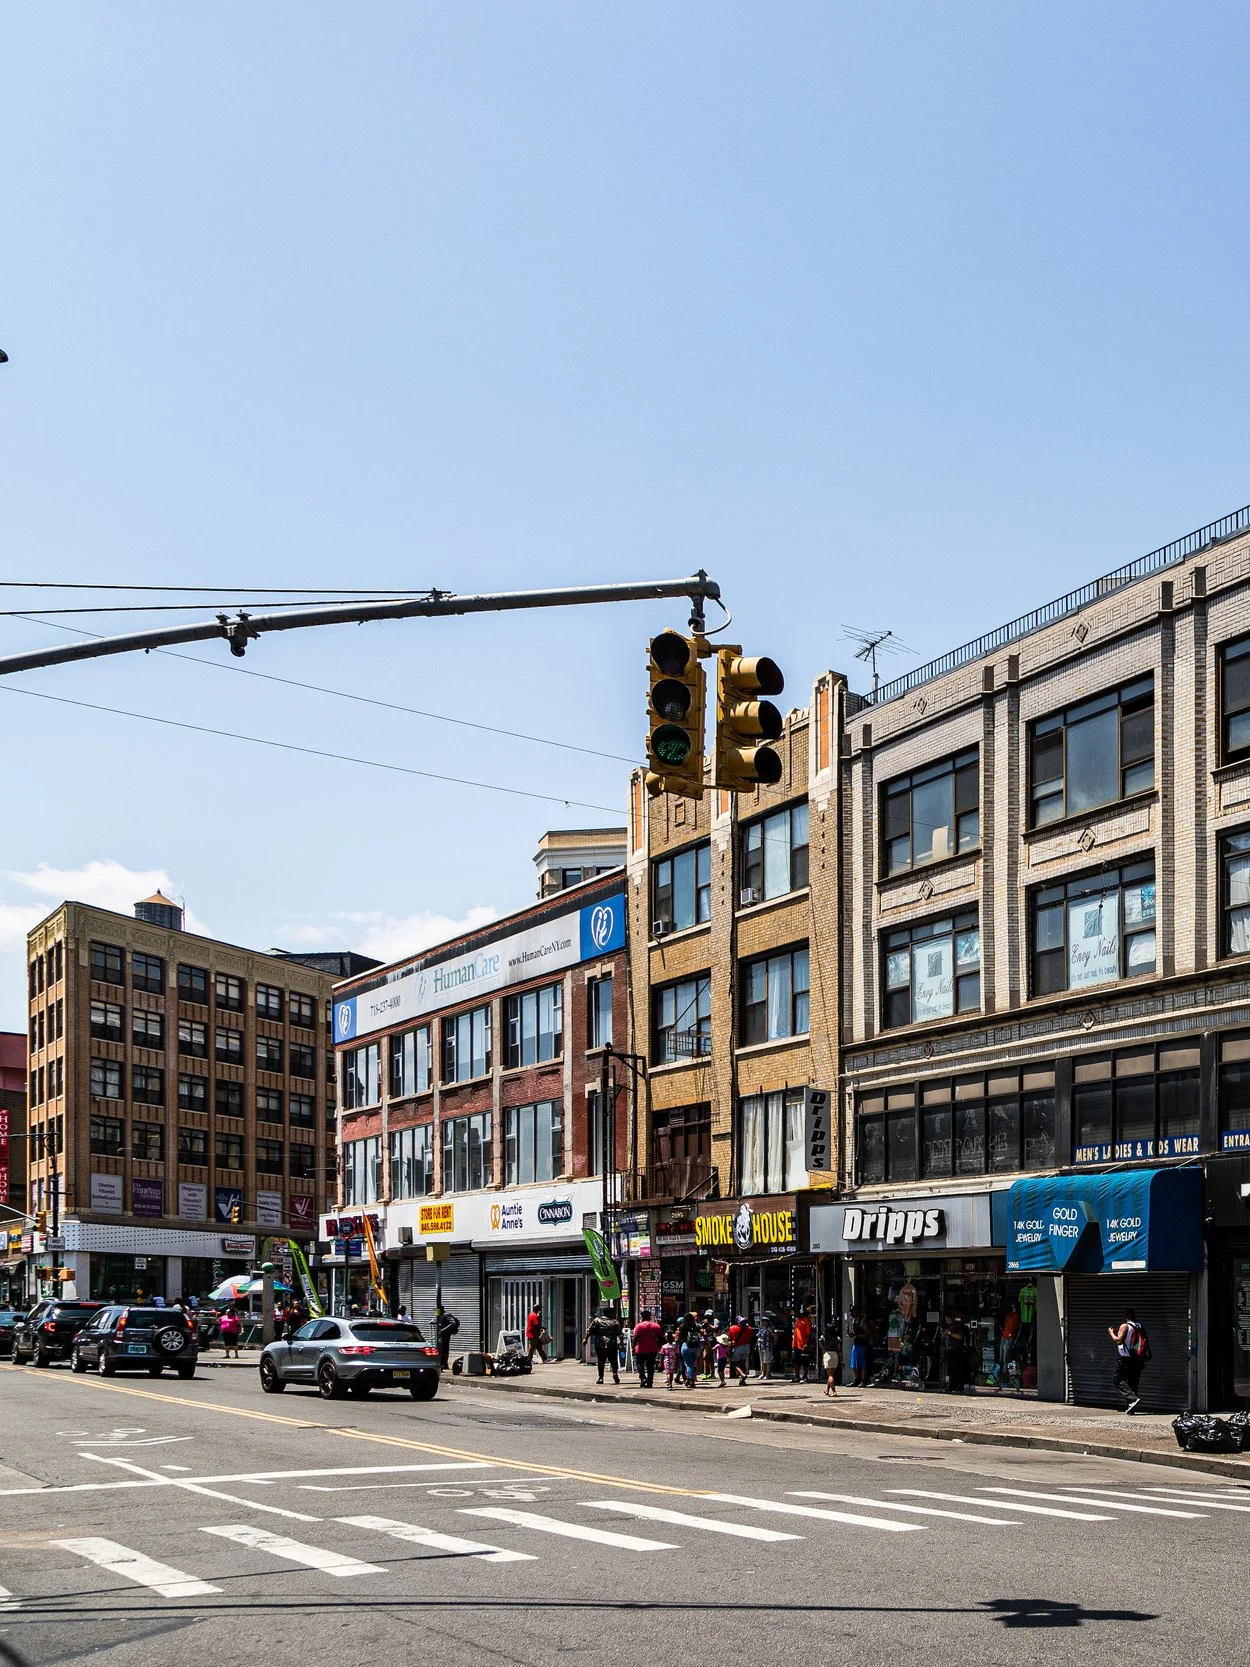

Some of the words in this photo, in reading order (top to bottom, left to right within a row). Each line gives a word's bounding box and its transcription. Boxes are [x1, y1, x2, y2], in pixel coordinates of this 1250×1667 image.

[508, 938, 571, 968] www.HumanCareNY.com
[1093, 935, 1117, 959] Nails
[433, 953, 500, 993] HumanCare
[370, 995, 401, 1017] 718-237-4000
[810, 1092, 826, 1167] Dripps
[1076, 1147, 1098, 1162] MEN'S
[1137, 1143, 1142, 1156] &
[1147, 1141, 1169, 1156] KDS
[1174, 1137, 1199, 1154] WEAR
[421, 1208, 432, 1220] STORE
[442, 1206, 451, 1219] RENT
[501, 1203, 522, 1216] Auntie
[539, 1205, 571, 1221] CINNABON
[1052, 1207, 1078, 1221] GOLD
[501, 1218, 523, 1230] Anne's
[695, 1215, 733, 1245] SMOKE
[752, 1210, 792, 1243] HOUSE
[842, 1206, 941, 1245] Dripps
[1013, 1220, 1025, 1230] 14K
[1026, 1219, 1045, 1229] GOLD
[1106, 1218, 1119, 1228] 14K
[1119, 1217, 1141, 1228] GOLD
[1015, 1233, 1042, 1243] JEWELRY
[1049, 1224, 1079, 1238] FINGER
[1108, 1231, 1138, 1242] JEWELRY
[662, 1281, 684, 1289] GSM
